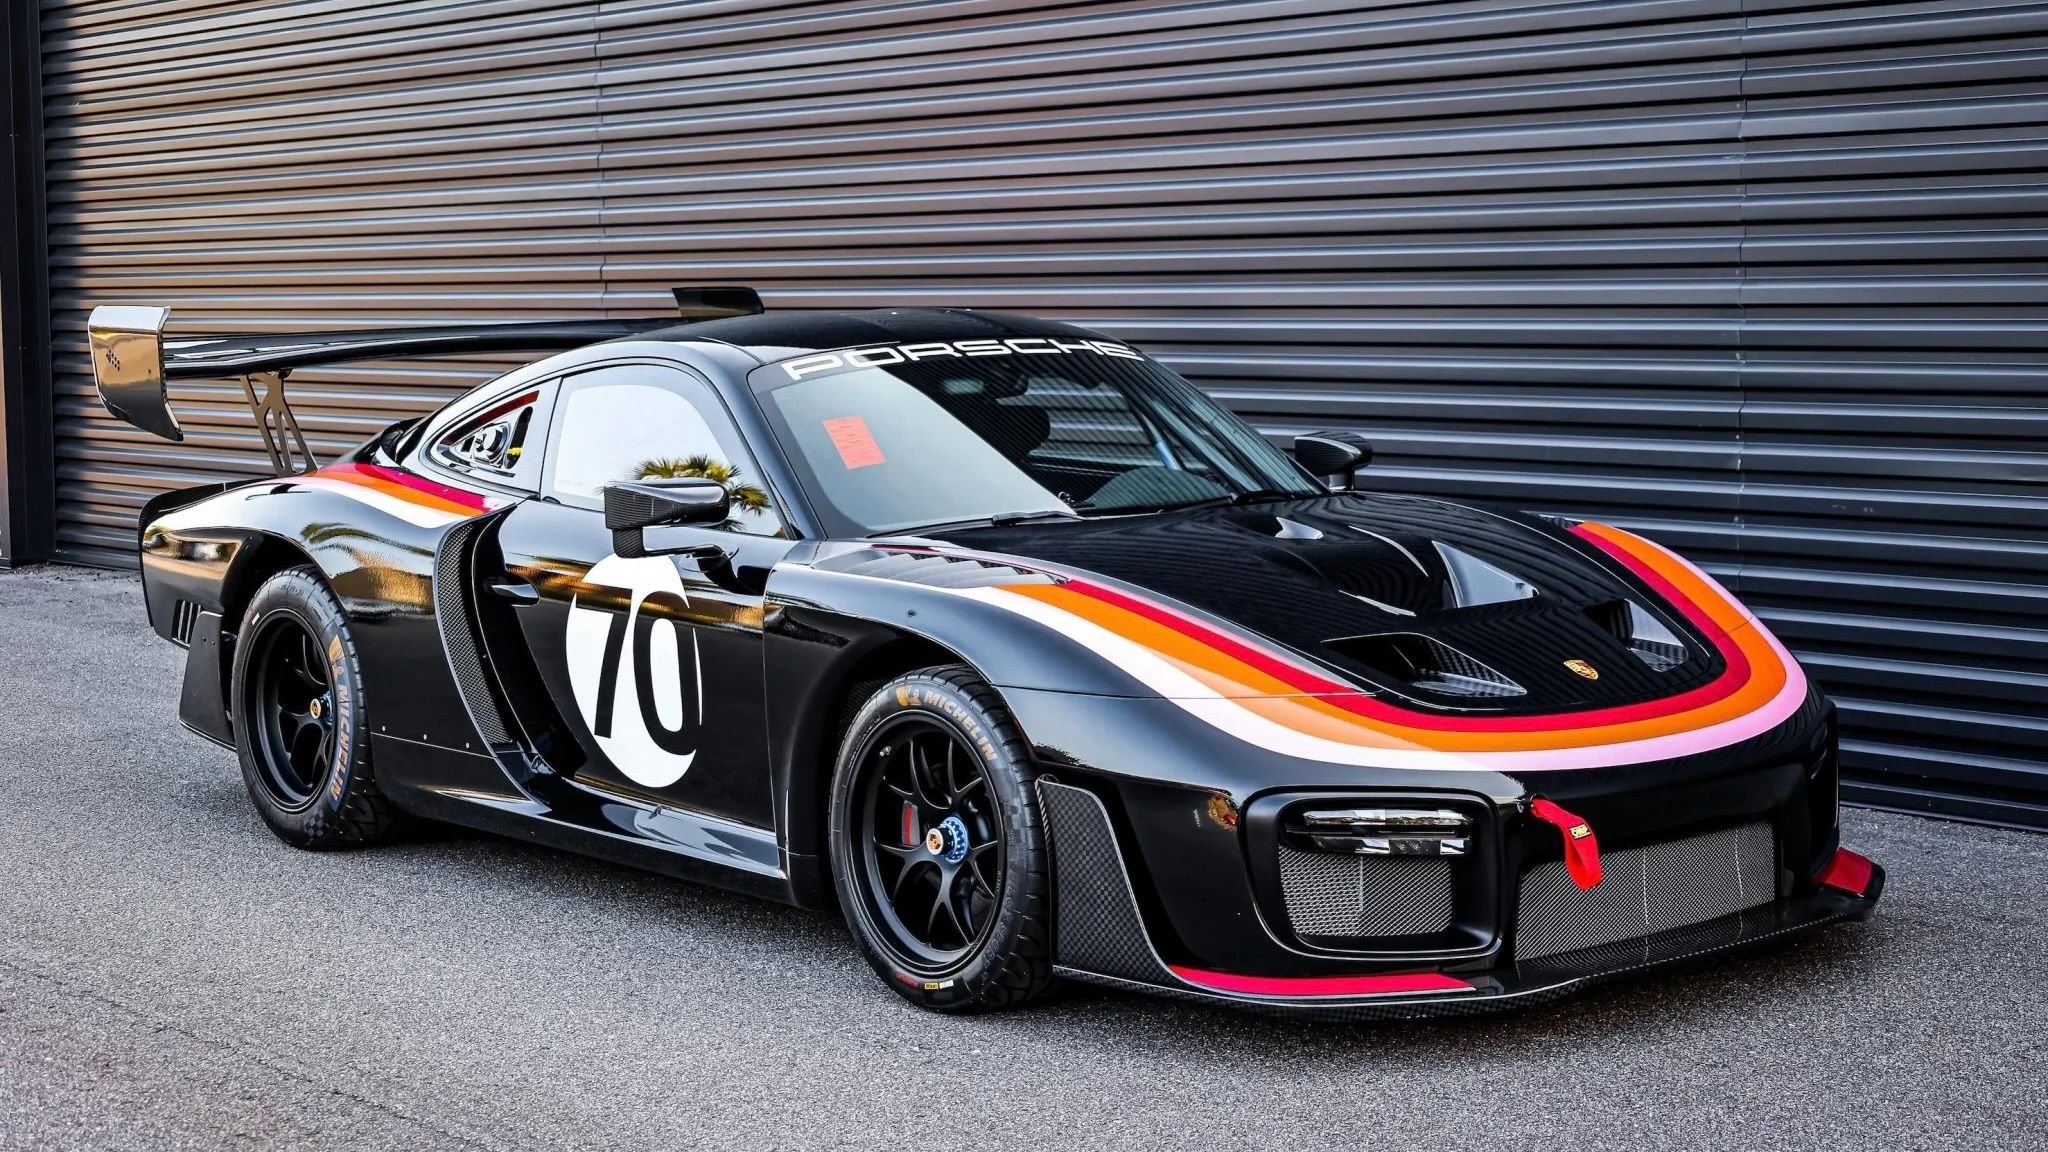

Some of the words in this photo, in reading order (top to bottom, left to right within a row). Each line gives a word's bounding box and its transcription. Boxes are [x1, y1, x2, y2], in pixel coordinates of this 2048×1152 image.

[780, 338, 1144, 381] PORSCHE
[575, 582, 701, 756] 70
[330, 684, 351, 801] MICHELIN
[923, 689, 997, 761] MICHELIN
